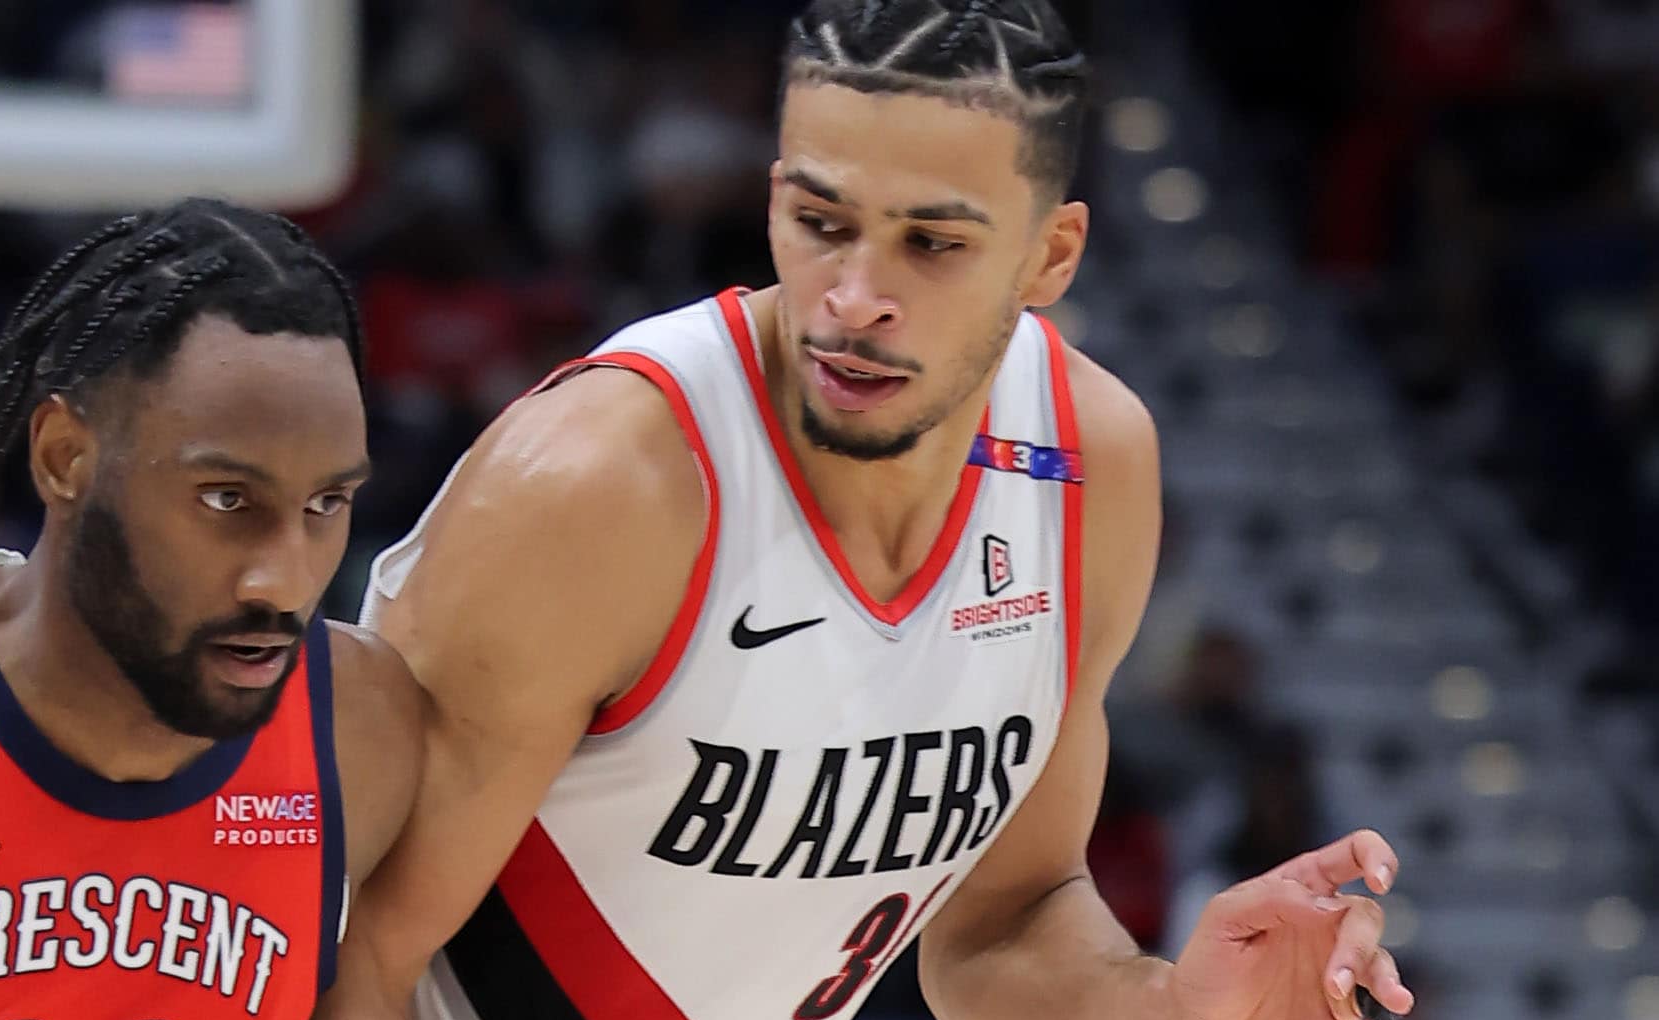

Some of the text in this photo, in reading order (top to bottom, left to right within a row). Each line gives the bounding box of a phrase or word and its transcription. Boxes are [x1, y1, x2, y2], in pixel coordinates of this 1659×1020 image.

[951, 591, 1052, 631] BRIGHTSIDE
[646, 714, 1033, 880] BLAZERS
[213, 828, 318, 846] PRODUCTS
